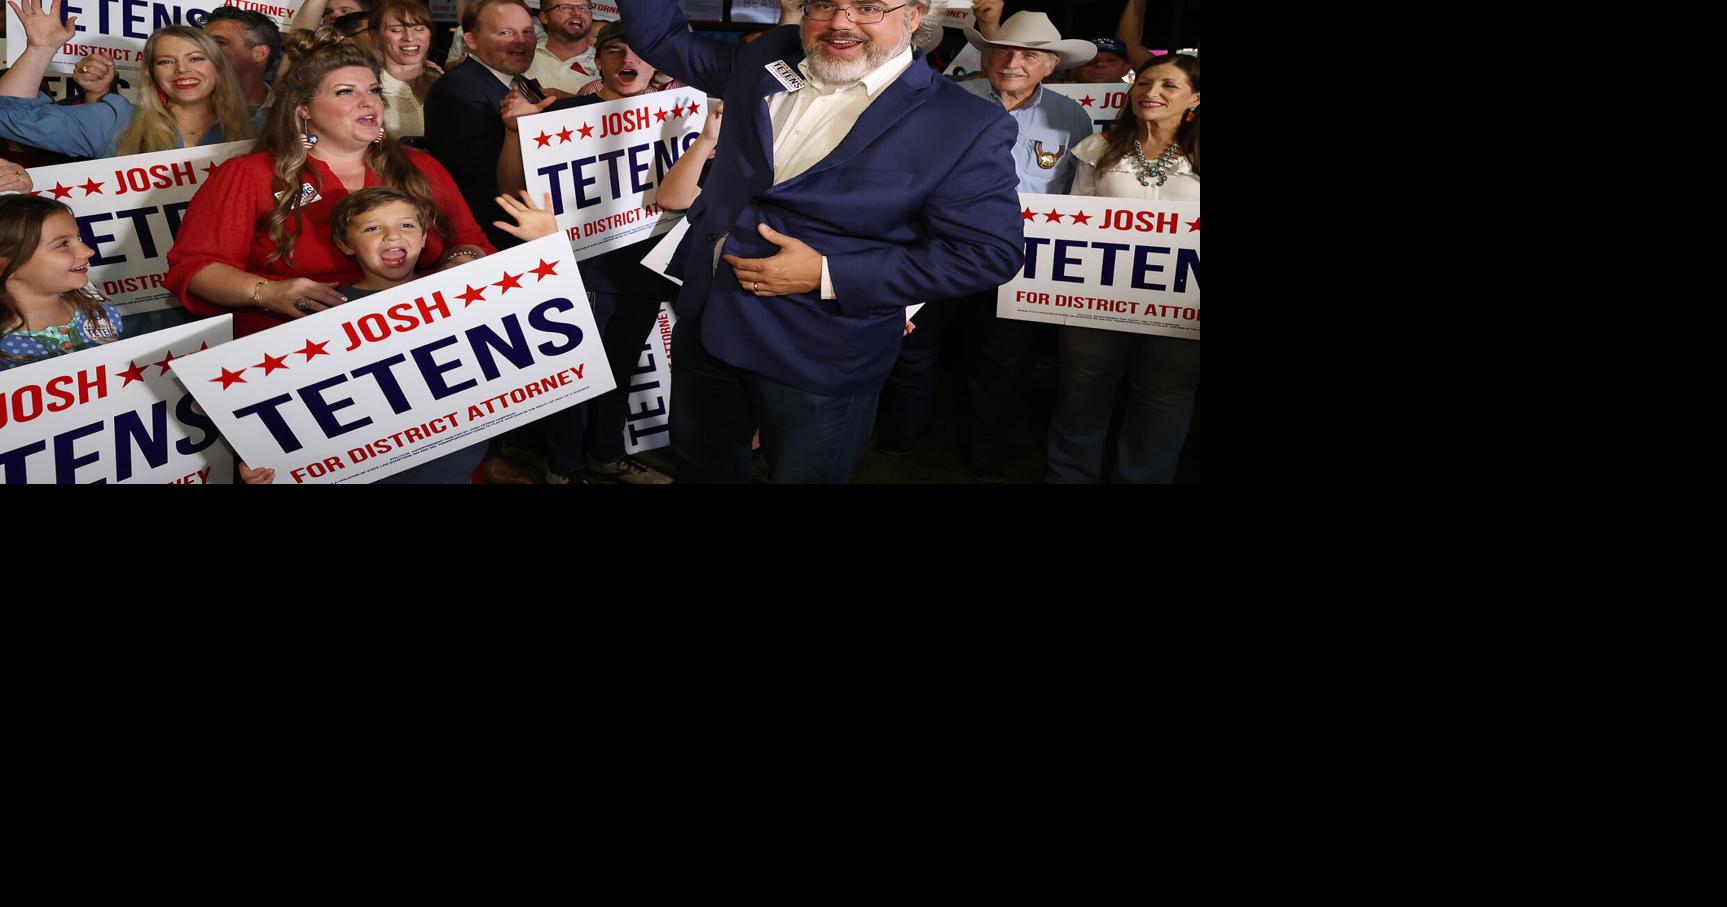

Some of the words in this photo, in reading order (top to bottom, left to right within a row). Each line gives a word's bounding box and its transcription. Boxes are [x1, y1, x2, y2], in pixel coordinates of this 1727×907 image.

[60, 0, 206, 39] ETEN
[774, 62, 801, 89] TETENS
[600, 106, 650, 139] JOSH
[115, 160, 198, 196] JOSH
[584, 207, 641, 238] DISTRICT
[1098, 208, 1179, 235] JOSH
[1015, 290, 1050, 306] FOR
[1054, 294, 1140, 315] DISTRICT
[341, 289, 452, 352] JOSH
[232, 297, 584, 455] TETENS
[289, 456, 345, 484] FOR
[347, 411, 459, 465] DISTRICT
[467, 363, 586, 422] ATTORNEY
